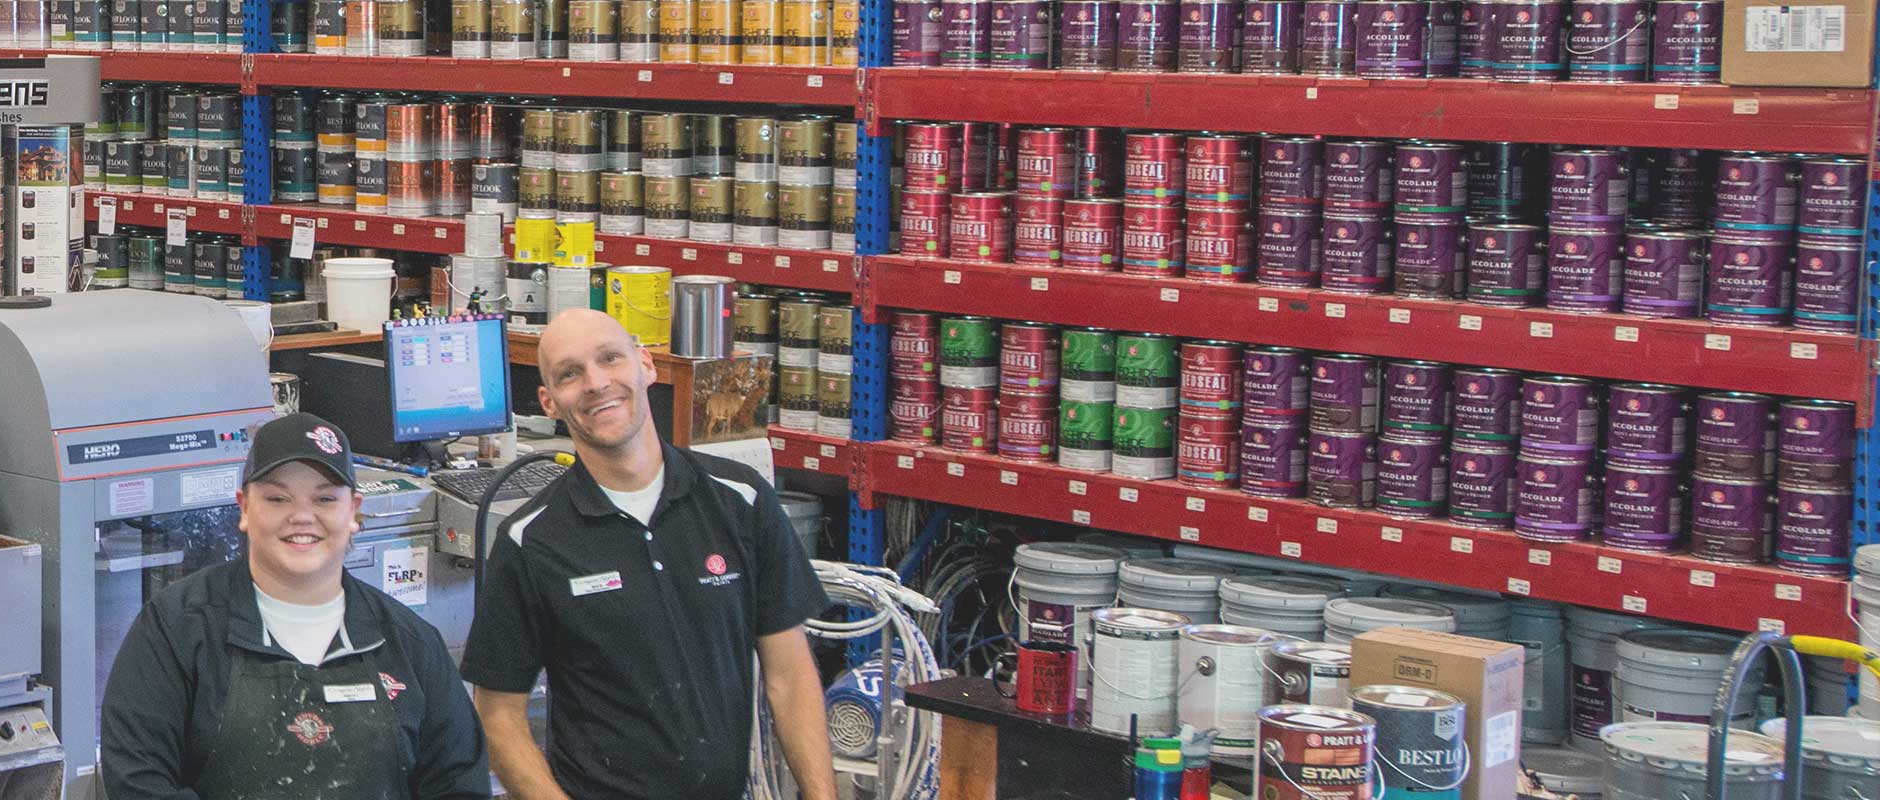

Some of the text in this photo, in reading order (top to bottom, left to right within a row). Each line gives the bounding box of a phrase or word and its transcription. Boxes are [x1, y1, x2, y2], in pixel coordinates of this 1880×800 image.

[906, 150, 943, 166] EDSEAL
[1126, 162, 1164, 180] EDSEAL
[1187, 166, 1225, 184] EDSEAL
[952, 221, 986, 238] EDSEAL
[526, 294, 534, 303] A
[893, 339, 929, 354] EDSEAL
[1002, 352, 1037, 369] EDSEAL
[944, 412, 980, 429] EDSEAL
[1323, 736, 1354, 746] PRATT
